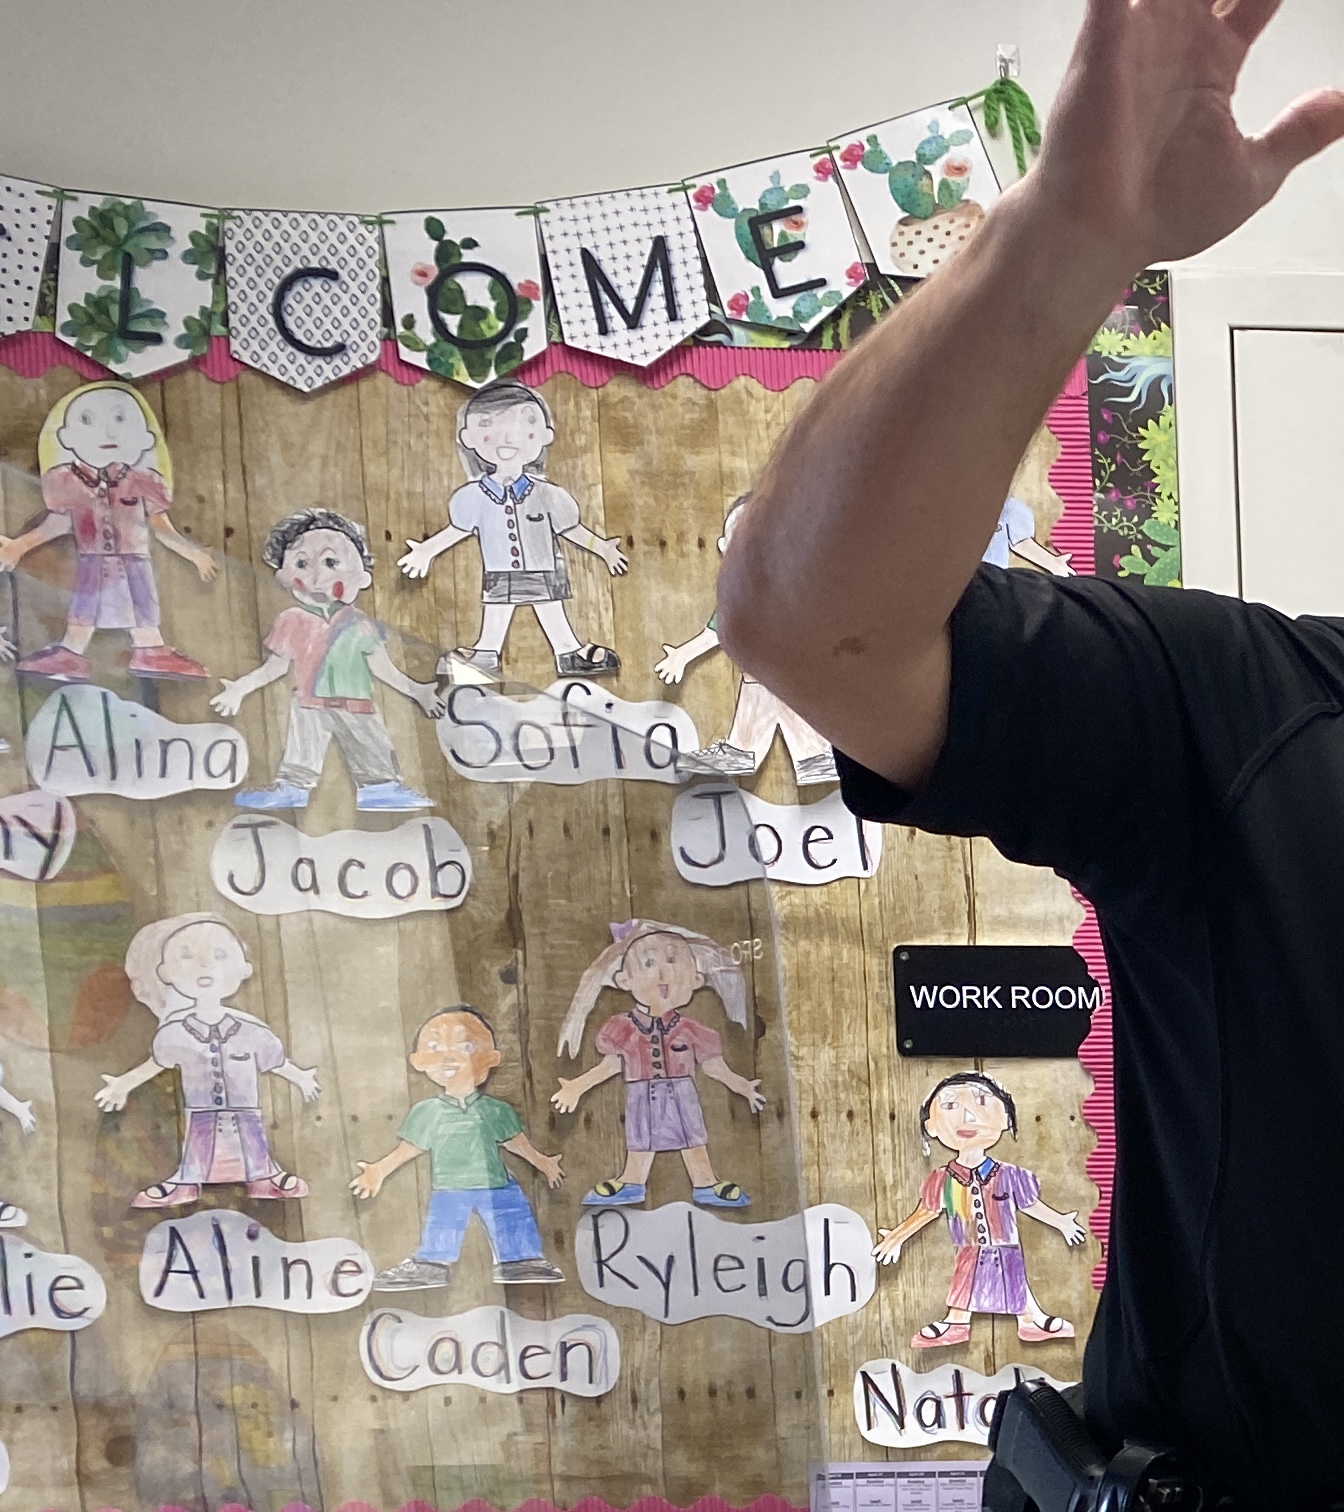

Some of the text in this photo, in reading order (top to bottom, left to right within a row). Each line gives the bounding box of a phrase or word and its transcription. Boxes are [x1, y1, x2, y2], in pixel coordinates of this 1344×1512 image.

[118, 203, 827, 357] LCOME
[42, 692, 242, 785] Alina
[446, 681, 681, 772] Sofia
[226, 819, 466, 903] Jacob
[679, 789, 873, 872] Joel
[909, 985, 1101, 1010] WORK ROOM
[0, 1234, 93, 1319] lie
[154, 1226, 366, 1300] Aline
[590, 1210, 860, 1328] Ryleigh
[367, 1313, 596, 1385] Caden
